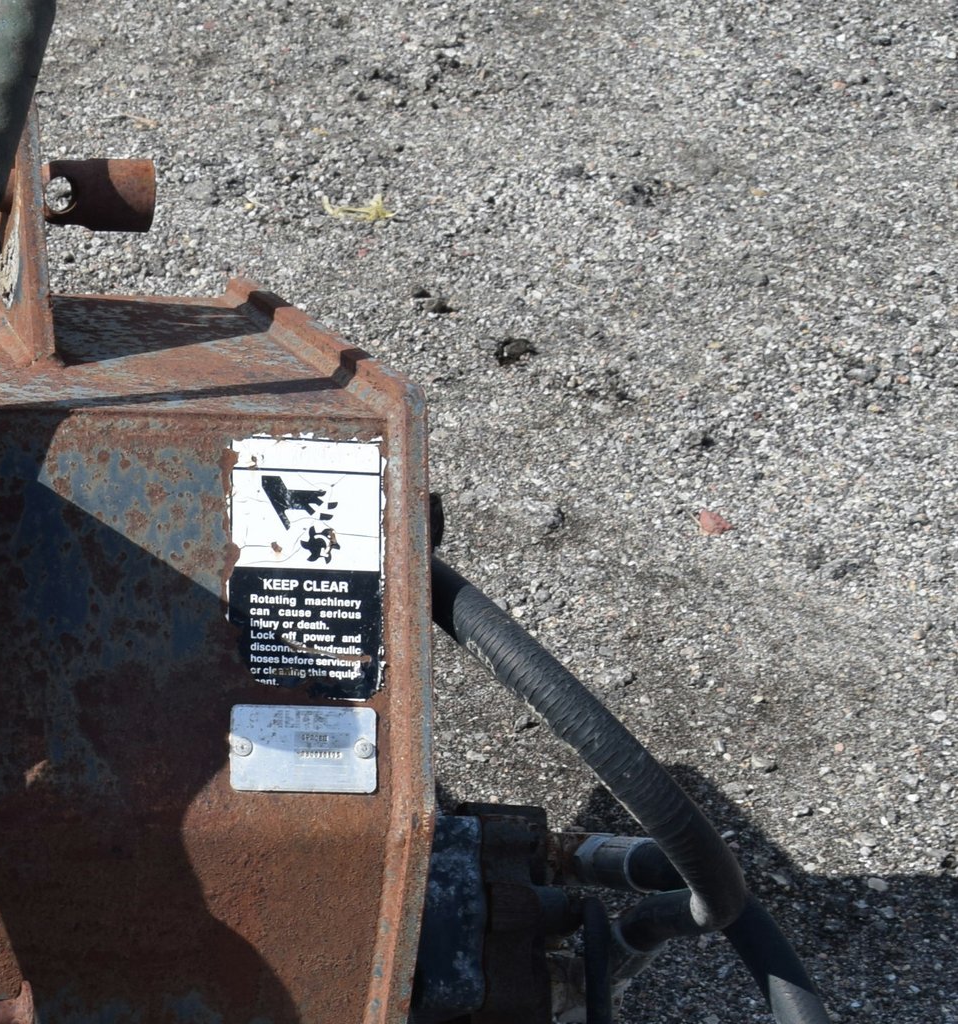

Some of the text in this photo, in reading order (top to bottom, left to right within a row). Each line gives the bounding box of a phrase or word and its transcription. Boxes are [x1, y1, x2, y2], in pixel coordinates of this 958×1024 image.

[263, 579, 348, 593] KEEP CLEAR
[250, 594, 361, 609] Rotating machinery
[250, 608, 361, 619] can cause serious
[250, 618, 279, 630] injury
[297, 621, 329, 630] death.
[250, 631, 361, 644] Lock off power and
[250, 654, 279, 664] hoses
[282, 655, 314, 665] before
